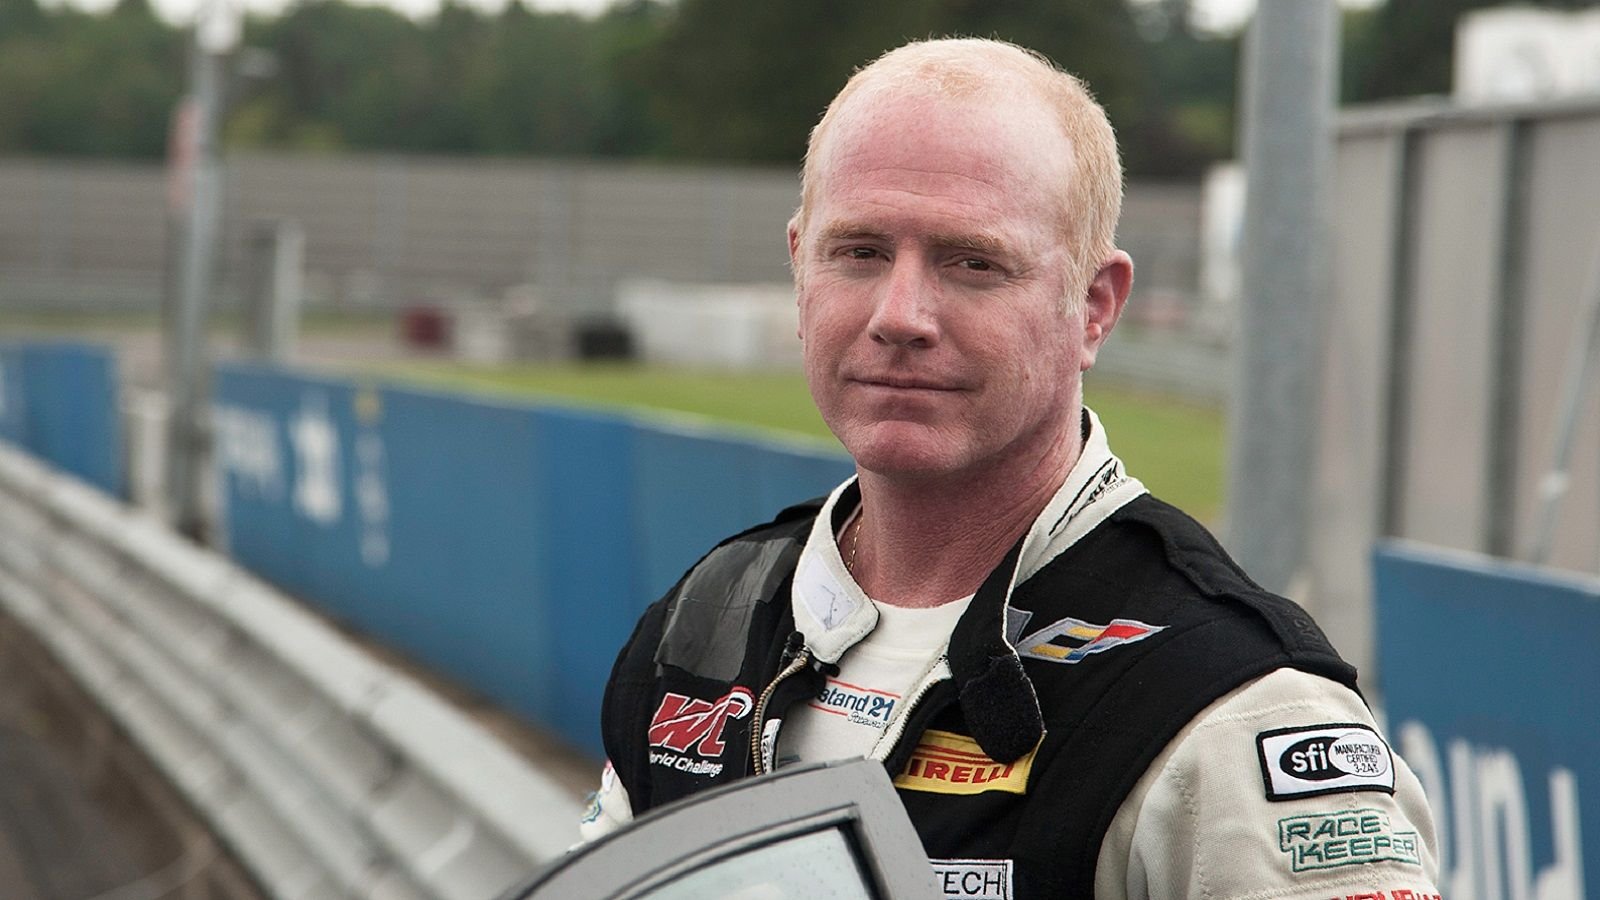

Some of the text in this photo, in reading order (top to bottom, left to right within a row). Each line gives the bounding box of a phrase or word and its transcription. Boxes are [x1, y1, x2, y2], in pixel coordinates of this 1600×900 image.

[867, 696, 895, 721] 21
[649, 751, 724, 778] orld Challenge
[908, 758, 1015, 784] IRELLI
[1291, 742, 1328, 773] sfi
[1298, 835, 1416, 864] KEEPER
